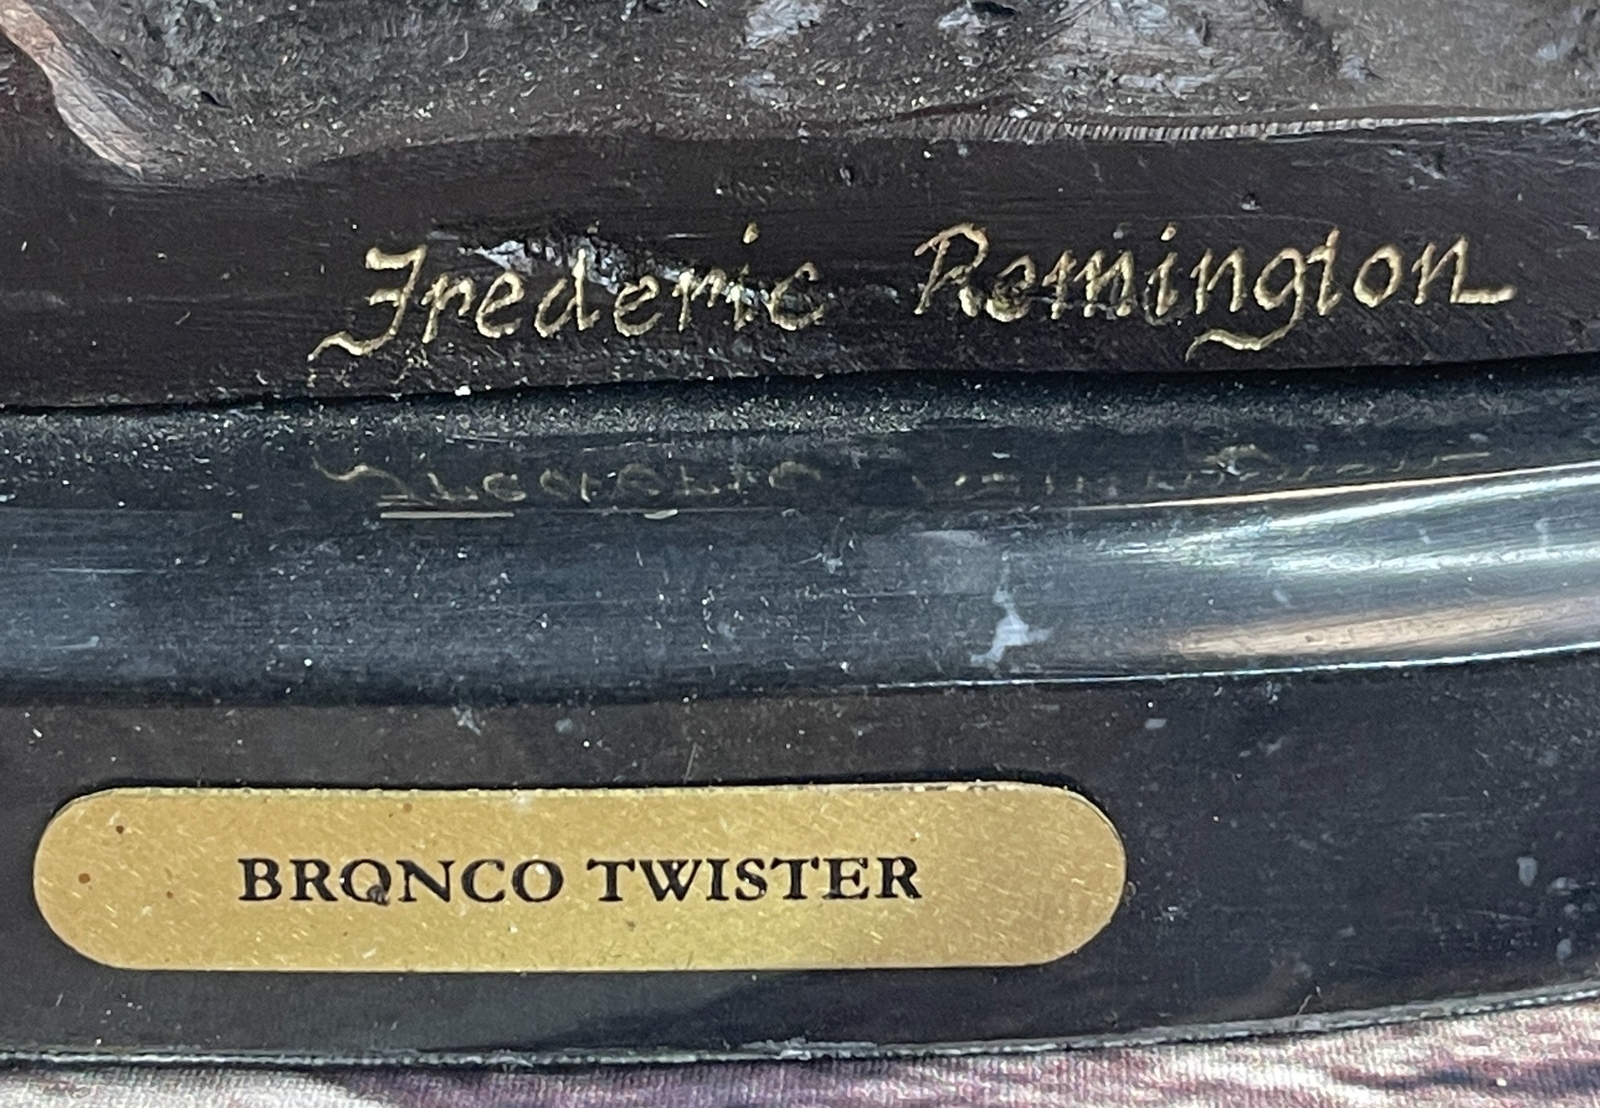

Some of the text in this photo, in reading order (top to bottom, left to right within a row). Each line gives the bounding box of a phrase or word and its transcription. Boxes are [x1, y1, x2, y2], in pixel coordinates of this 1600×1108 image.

[307, 221, 1515, 362] Frederic Remington
[237, 856, 923, 906] BRONCO TWISTER
